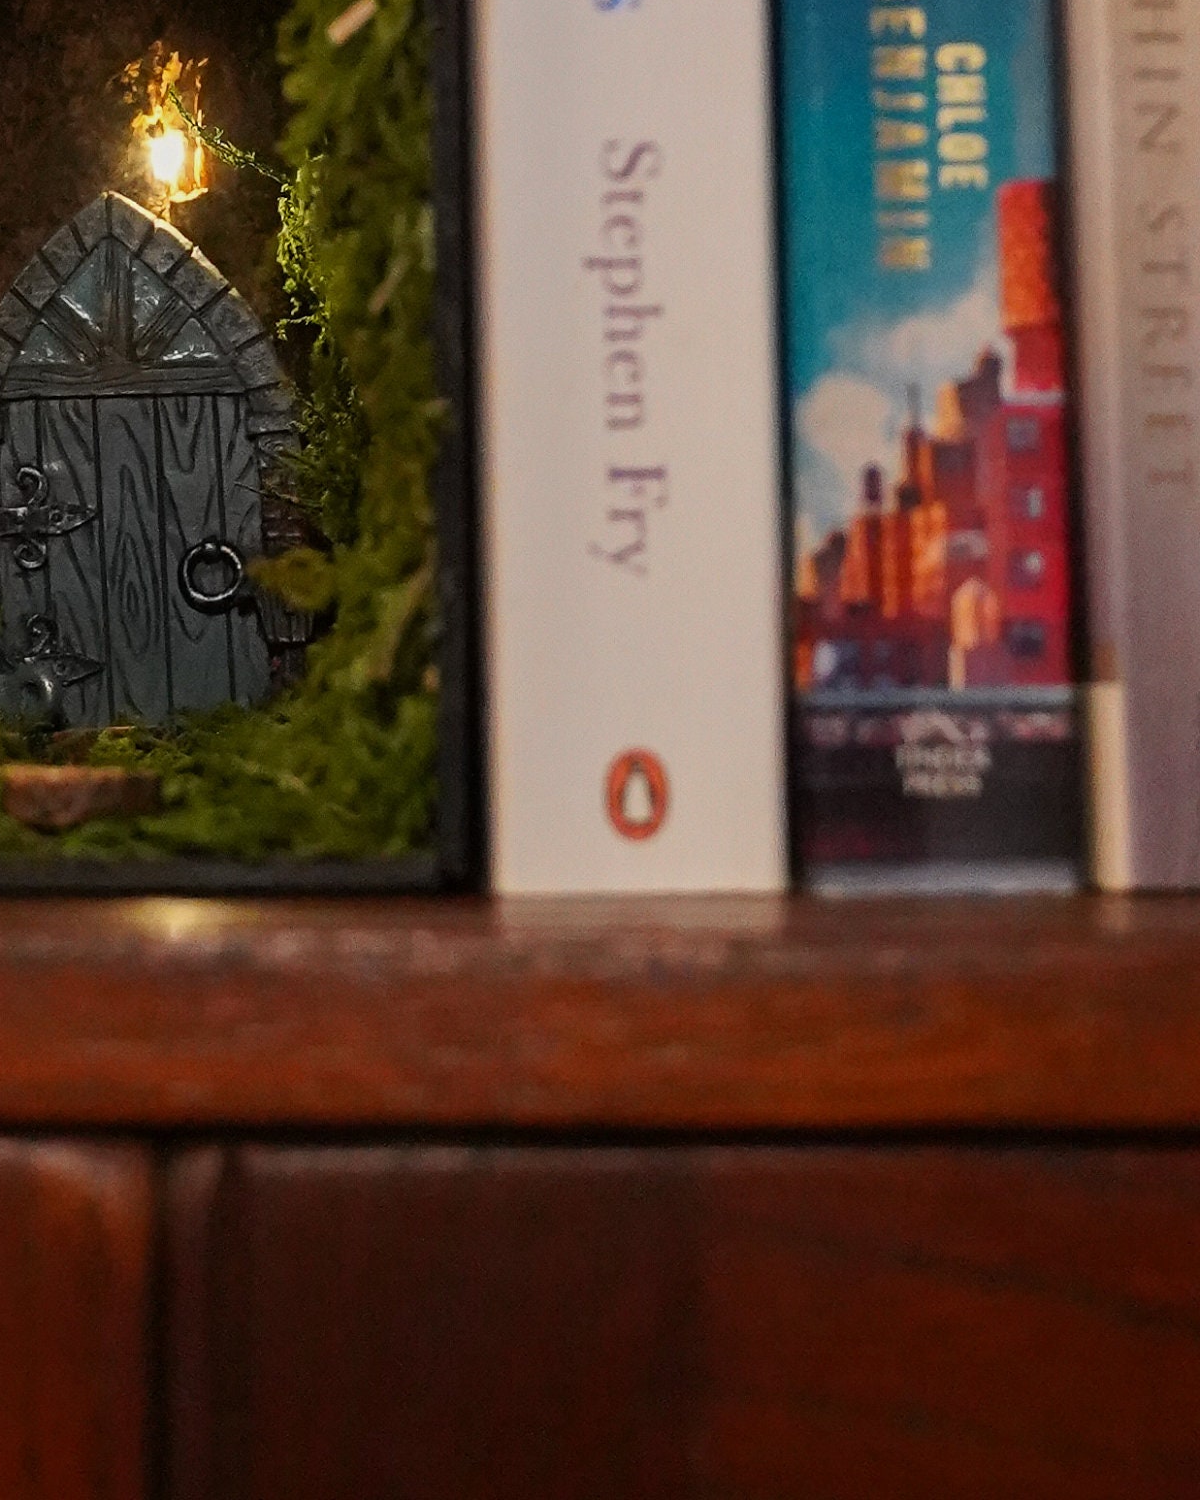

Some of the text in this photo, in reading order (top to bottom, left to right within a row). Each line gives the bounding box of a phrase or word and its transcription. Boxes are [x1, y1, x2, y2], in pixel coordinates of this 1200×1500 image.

[934, 41, 989, 190] CHLOE
[582, 137, 668, 578] Stephen Fry
[1138, 202, 1192, 489] STREET
